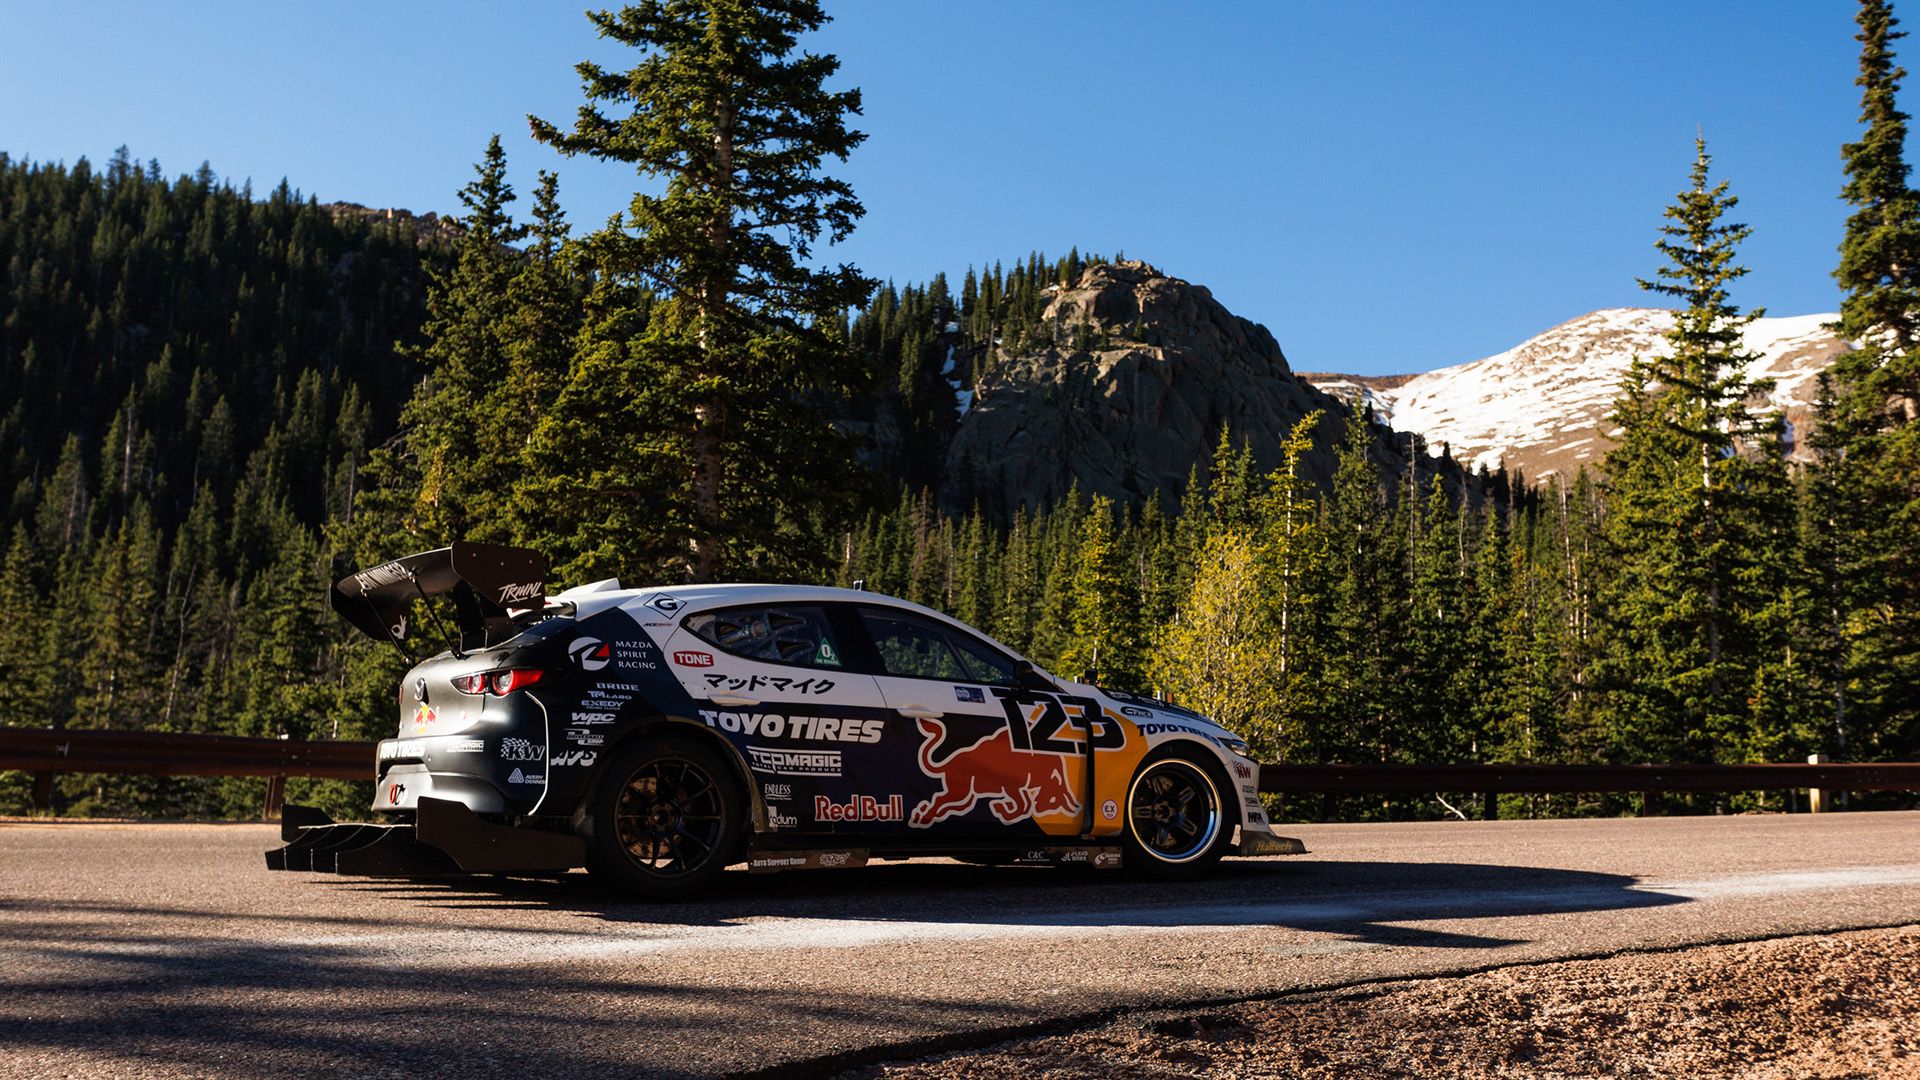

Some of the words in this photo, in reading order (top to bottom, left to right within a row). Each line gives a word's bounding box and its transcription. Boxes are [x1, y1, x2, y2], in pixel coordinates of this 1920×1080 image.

[654, 598, 679, 611] G
[615, 640, 653, 649] MAZDA
[617, 650, 648, 659] SPIRIT
[676, 653, 712, 665] TONE
[618, 661, 656, 670] RACING
[596, 682, 640, 691] BRIDE
[703, 673, 836, 695] マッドマイク
[581, 700, 625, 708] EXEDY
[698, 709, 785, 738] TOYO
[787, 715, 885, 744] TIRES
[989, 686, 1126, 757] 123
[1137, 723, 1177, 737] TOYO
[507, 744, 546, 761] KW
[764, 783, 792, 795] ENDLESS
[814, 794, 860, 822] Red
[860, 794, 904, 822] Bull
[1104, 804, 1115, 813] EX
